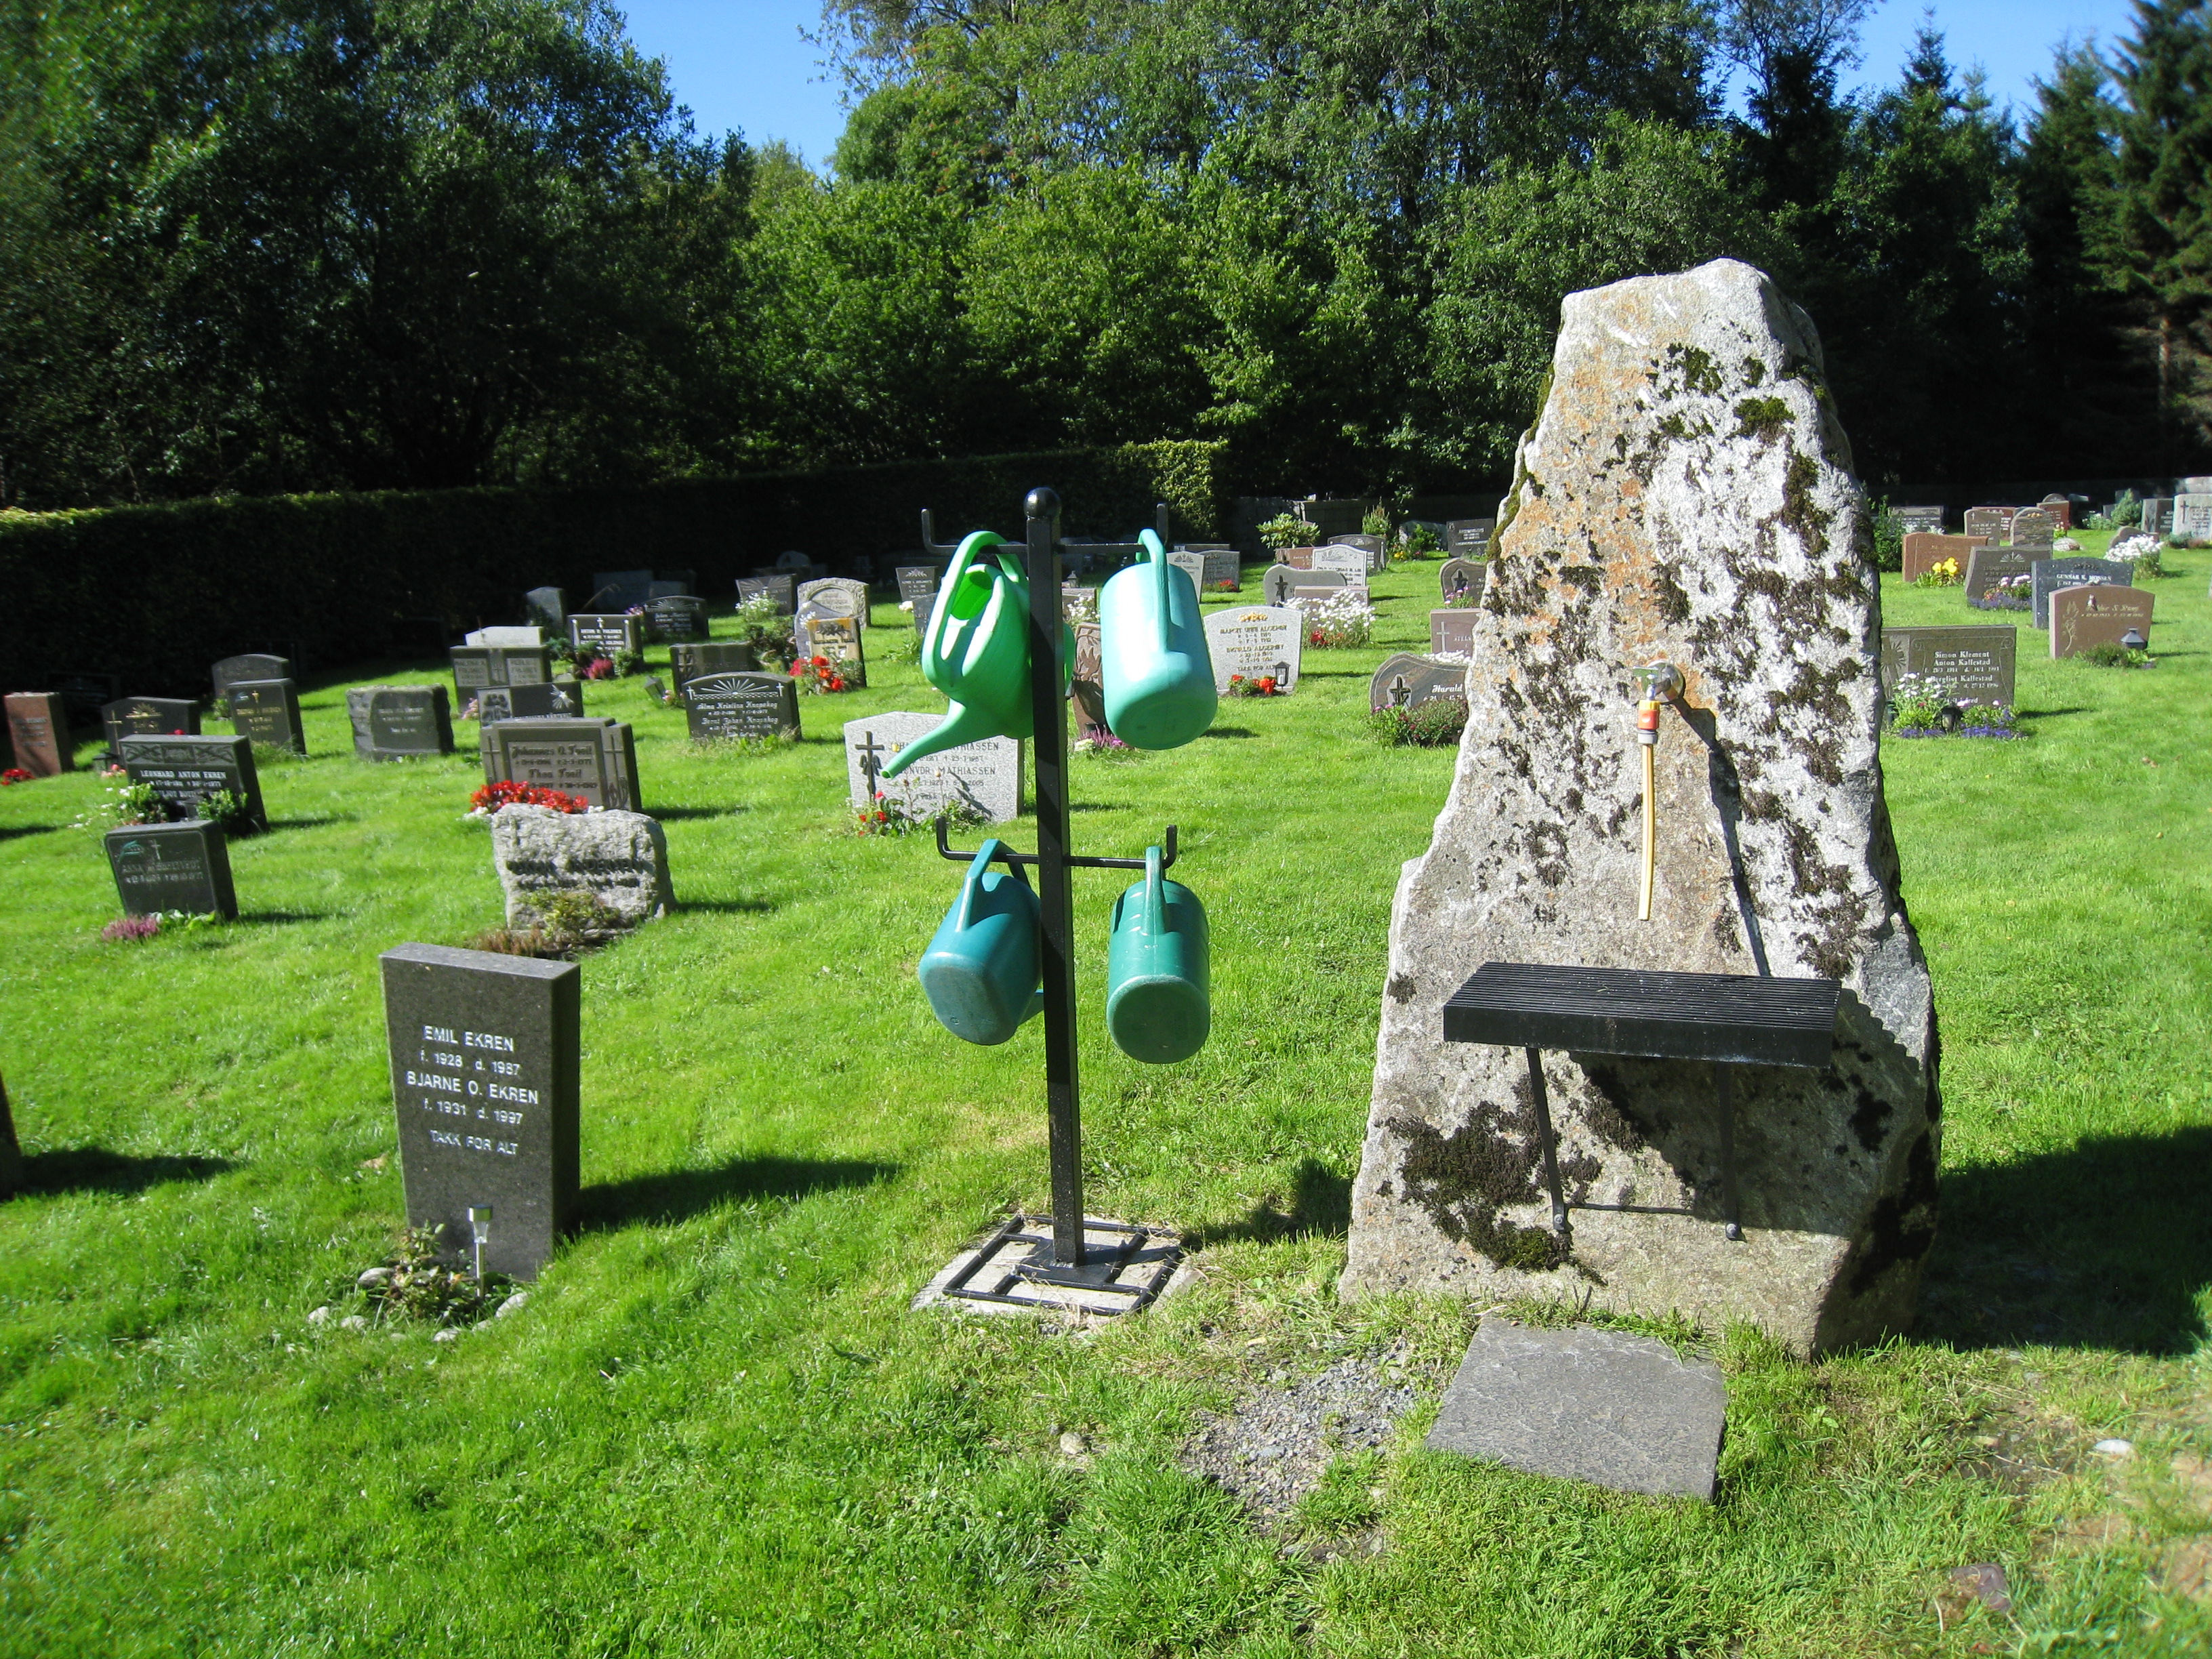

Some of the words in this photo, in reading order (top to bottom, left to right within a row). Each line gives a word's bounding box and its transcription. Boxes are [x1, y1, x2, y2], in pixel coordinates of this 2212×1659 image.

[1958, 658, 1990, 666] Kallestad
[1432, 684, 1463, 693] Harald
[1960, 674, 1993, 682] Kallestad
[178, 771, 201, 779] ANTON
[423, 1025, 459, 1044] EMIL
[465, 1031, 514, 1051] EKREN
[420, 1048, 428, 1062] f.
[434, 1052, 464, 1067] 1928
[475, 1059, 486, 1071] d.
[491, 1061, 521, 1076] 1987
[407, 1071, 462, 1092] BJARNE
[468, 1080, 483, 1096] O.
[489, 1083, 539, 1105] EKREN
[424, 1098, 432, 1110] f.
[436, 1101, 467, 1116] 1931
[476, 1107, 489, 1119] d.
[493, 1109, 524, 1125] 1997
[430, 1130, 462, 1147] TAKK
[466, 1135, 492, 1151] FOR
[496, 1140, 518, 1155] ALT
